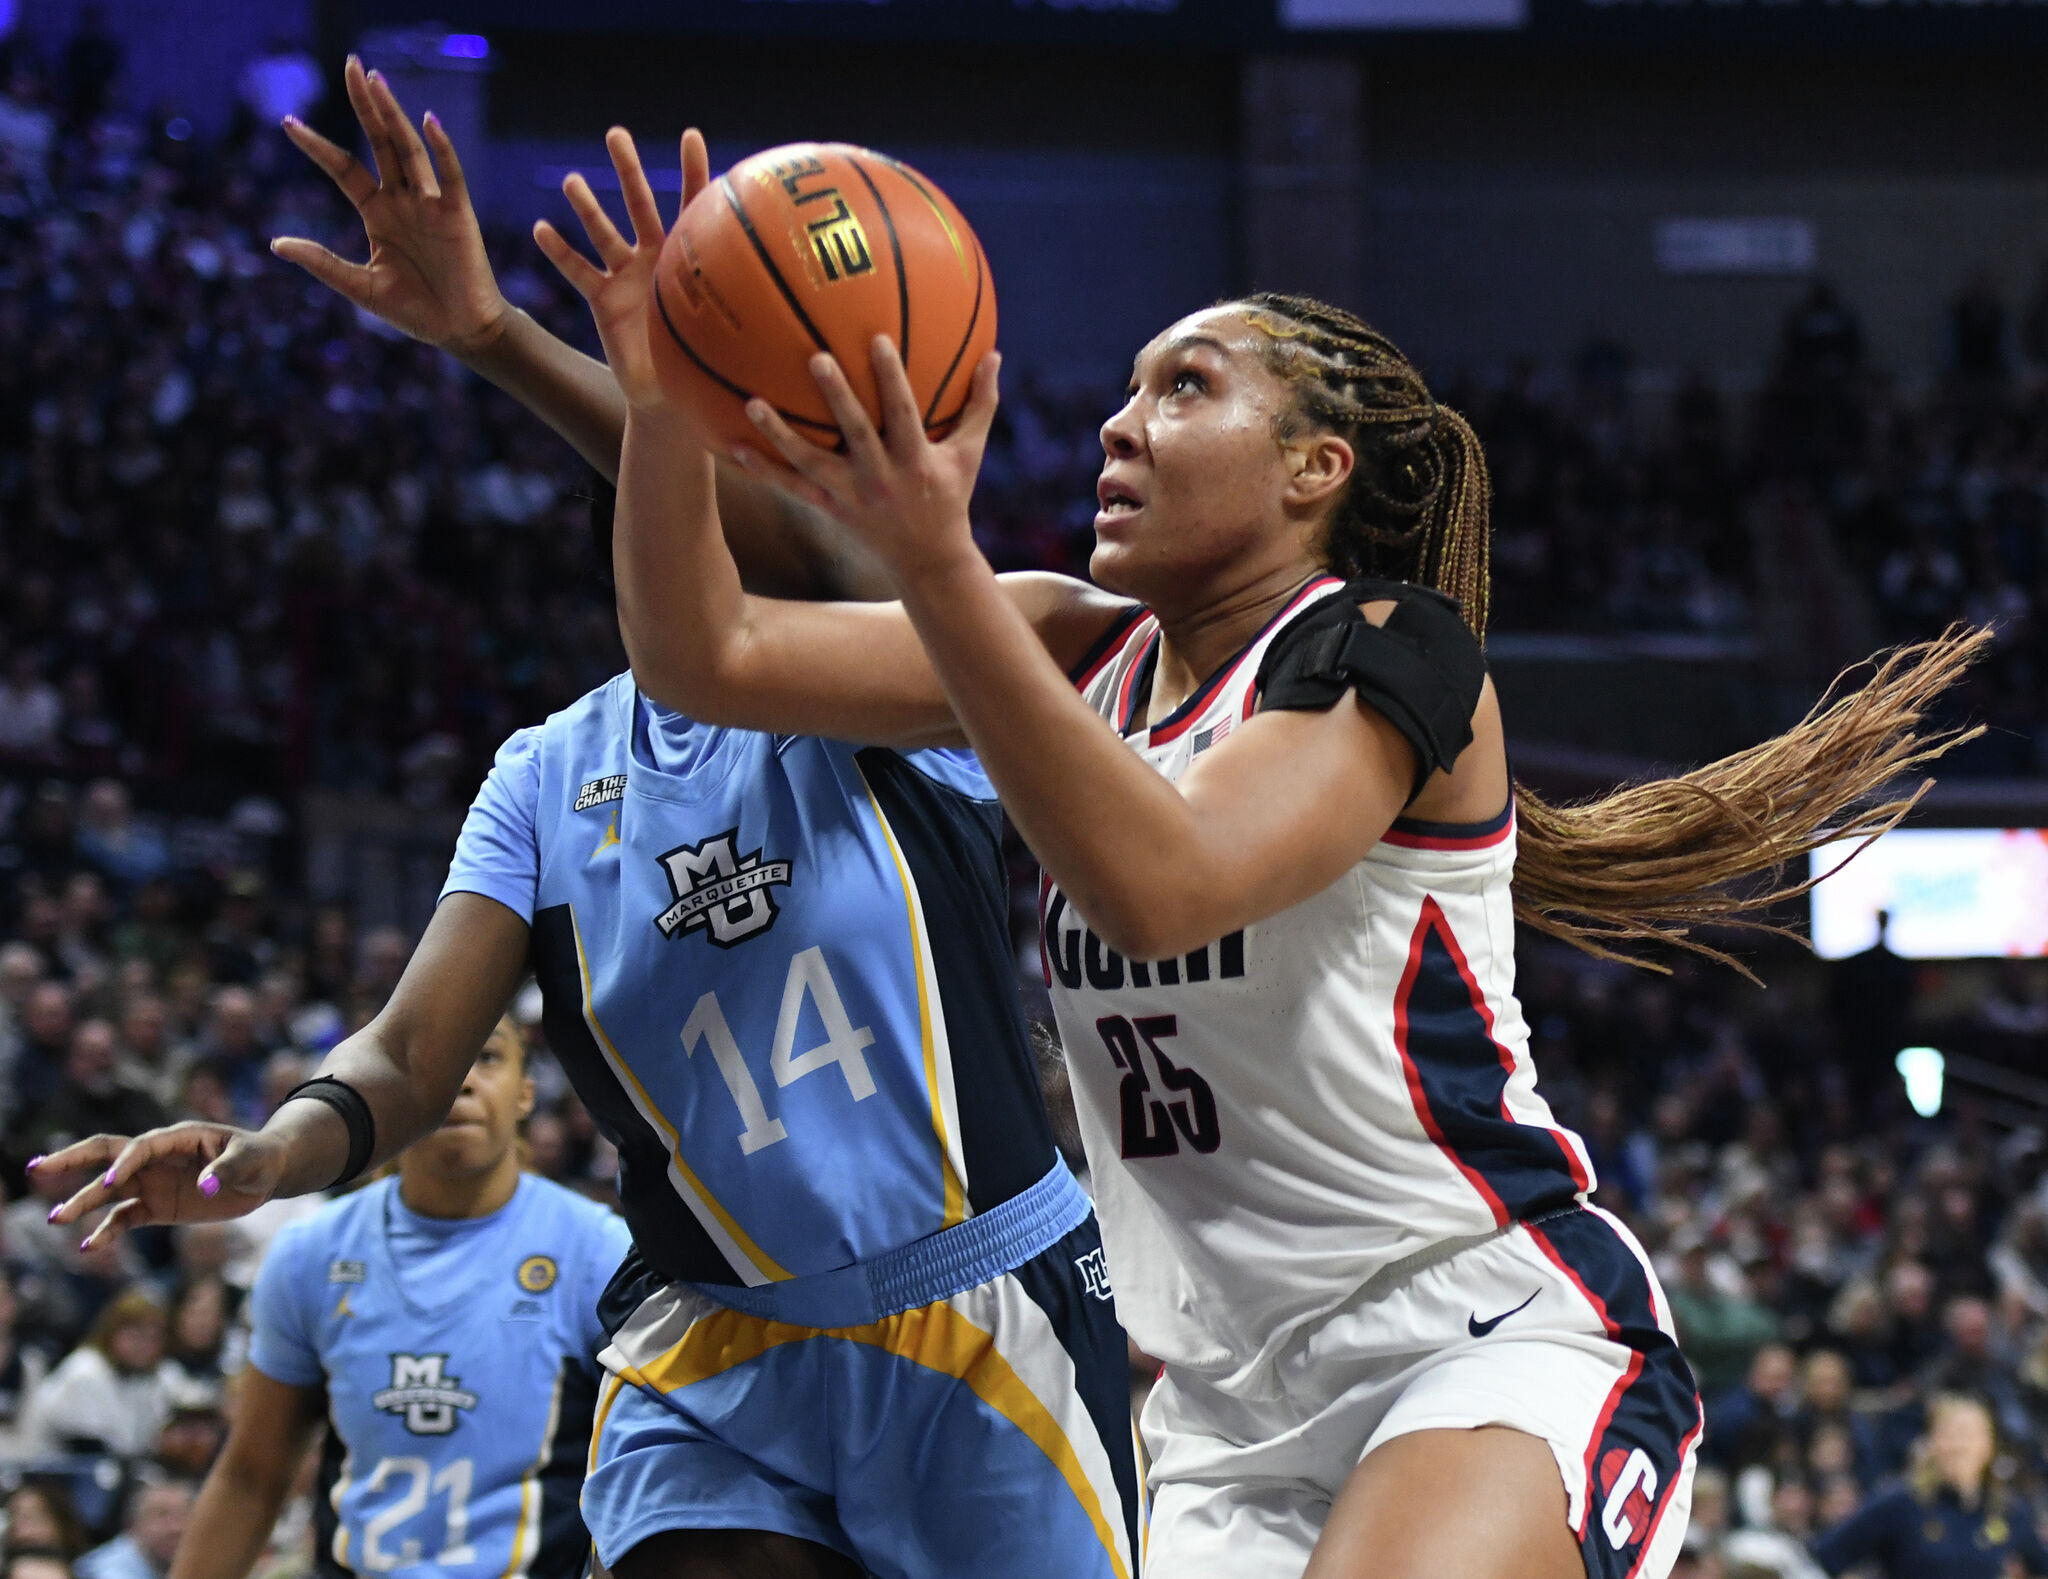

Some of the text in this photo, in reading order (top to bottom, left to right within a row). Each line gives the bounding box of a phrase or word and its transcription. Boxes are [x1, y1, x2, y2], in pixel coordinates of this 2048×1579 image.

[580, 775, 628, 798] BE THE
[666, 866, 782, 926] MARQUETTE
[680, 945, 877, 1157] 14
[1096, 1014, 1221, 1160] 25
[363, 1456, 477, 1573] 21
